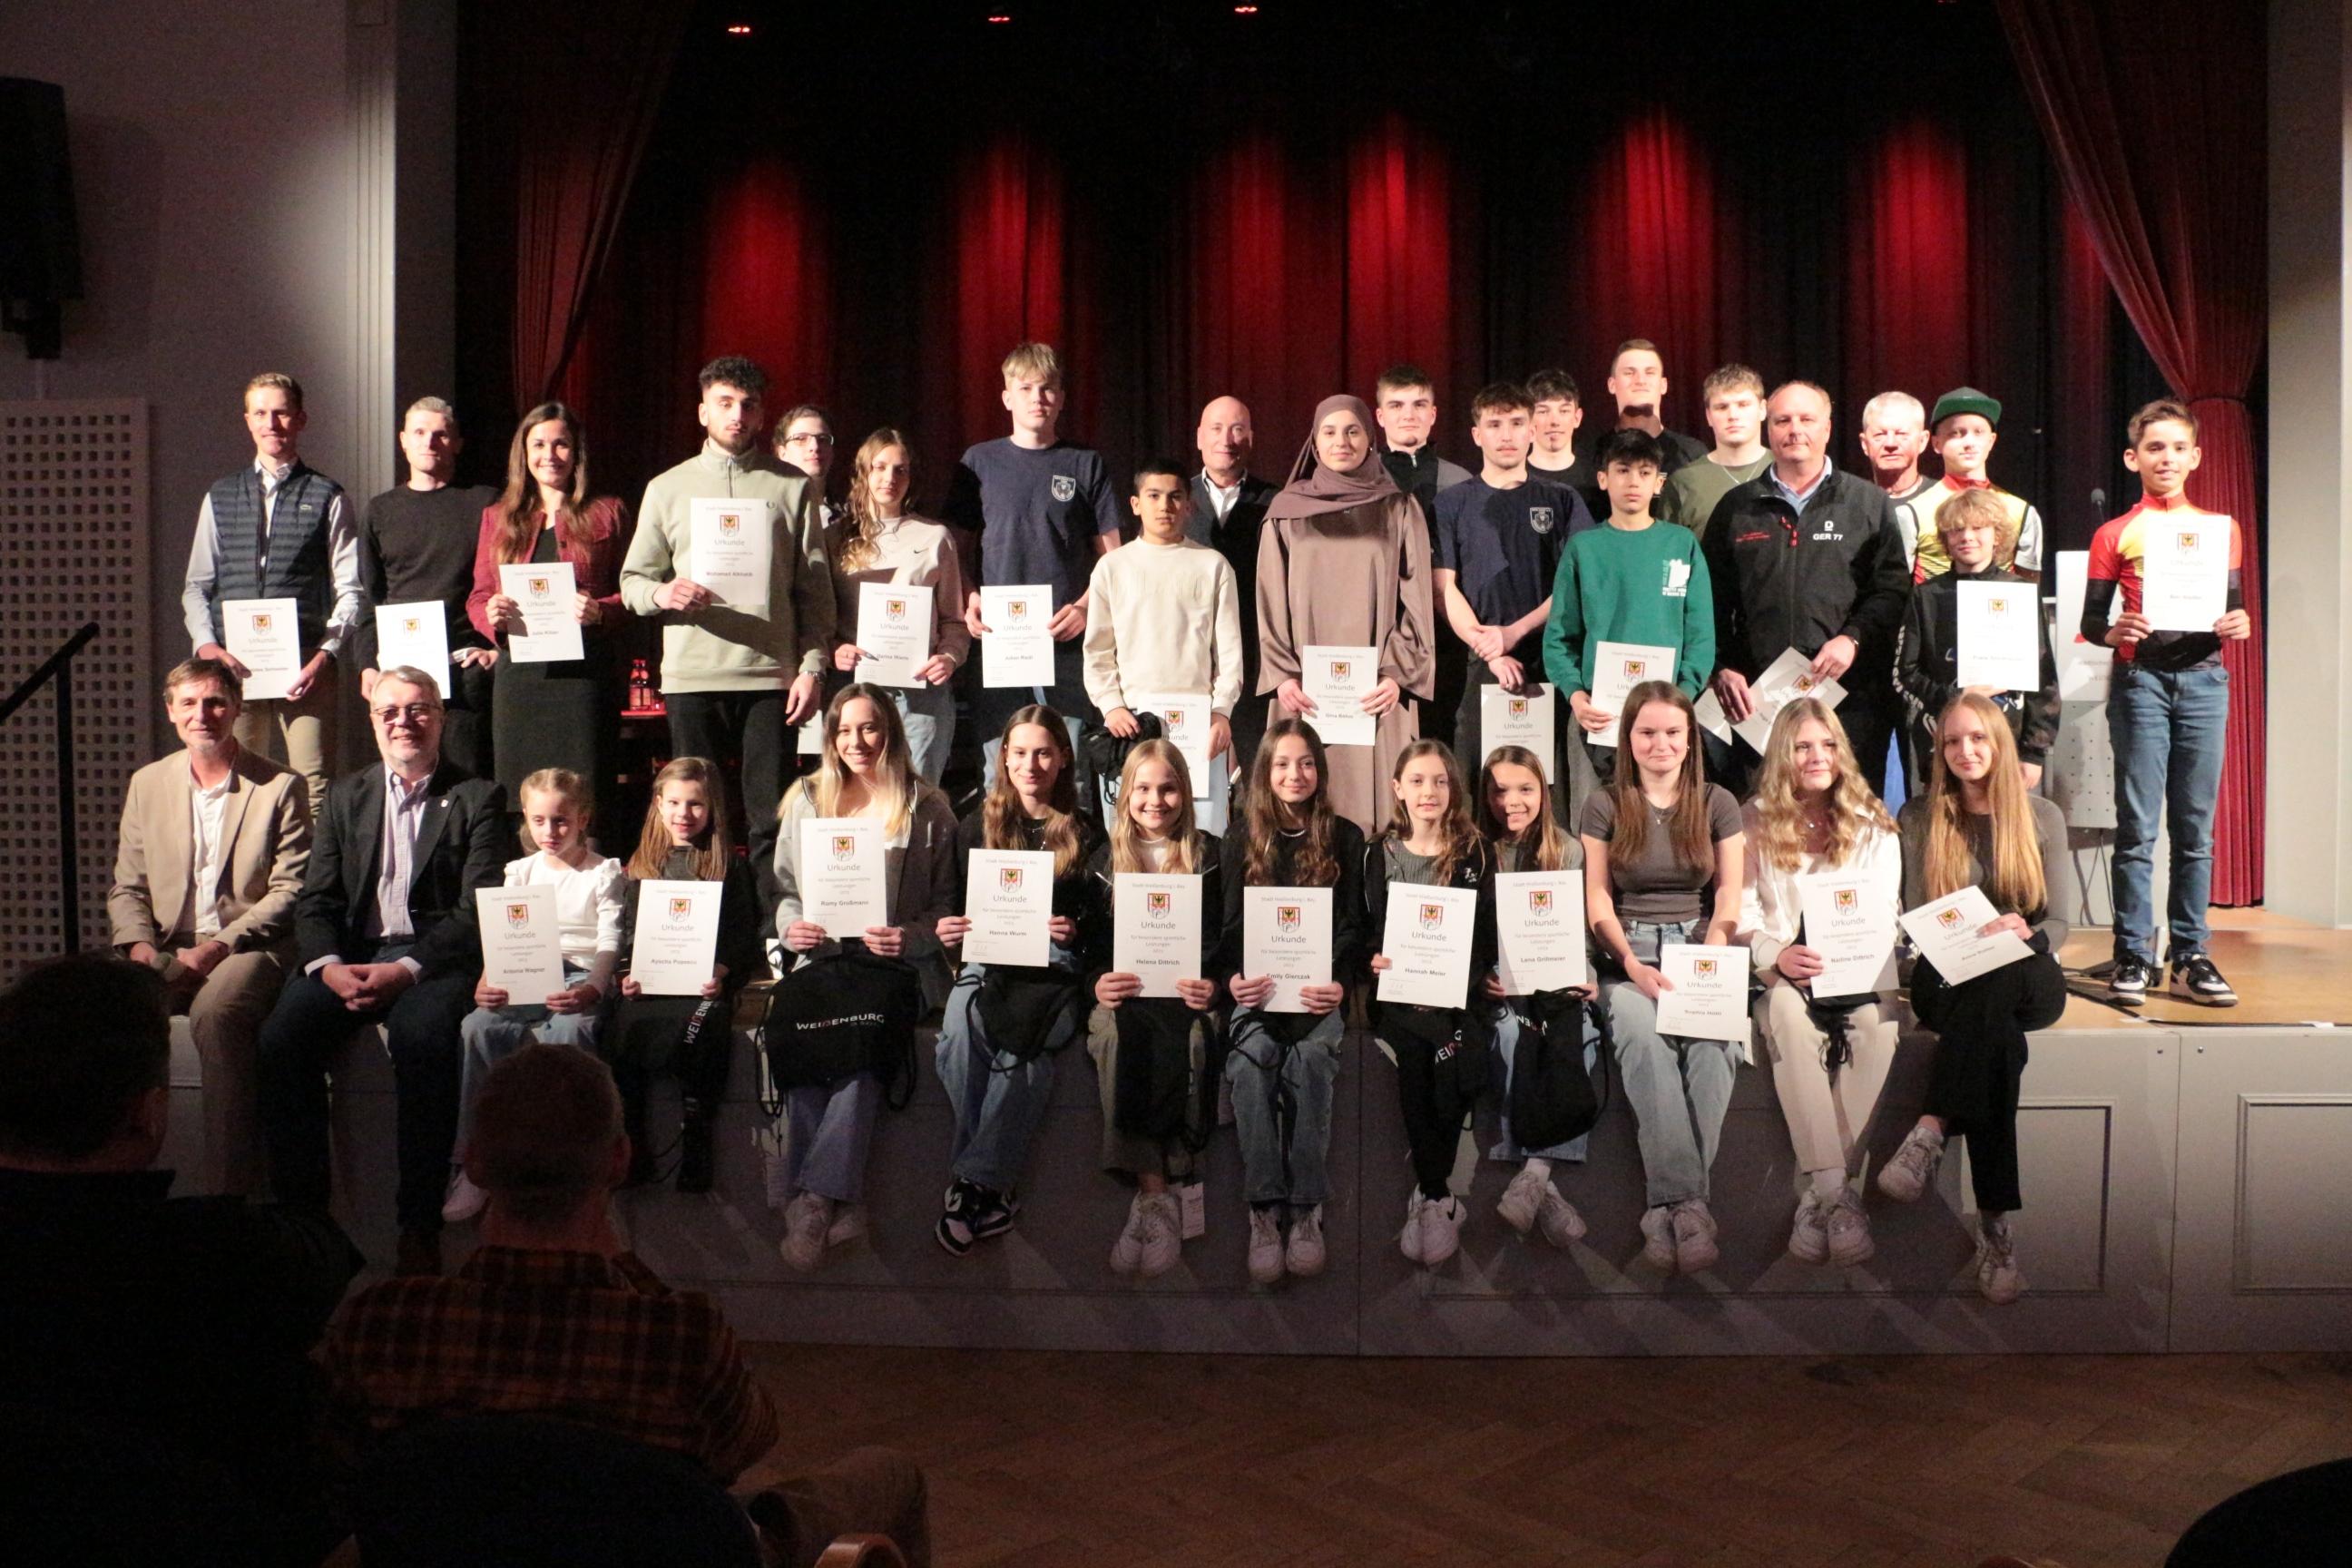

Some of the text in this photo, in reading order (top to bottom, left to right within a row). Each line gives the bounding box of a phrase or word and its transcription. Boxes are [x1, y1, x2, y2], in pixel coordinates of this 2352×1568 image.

[1812, 533, 1844, 541] GER 77
[880, 623, 909, 632] Urkunde
[1326, 683, 1356, 691] Urkunde
[993, 895, 1027, 903] Urkunde
[1142, 921, 1176, 929] Urkunde
[1524, 918, 1560, 927] Urkunde
[1831, 917, 1866, 928] Urkunde
[662, 924, 694, 932] Urkunde
[505, 931, 536, 940] Urkunde
[1411, 931, 1447, 942] Urkunde
